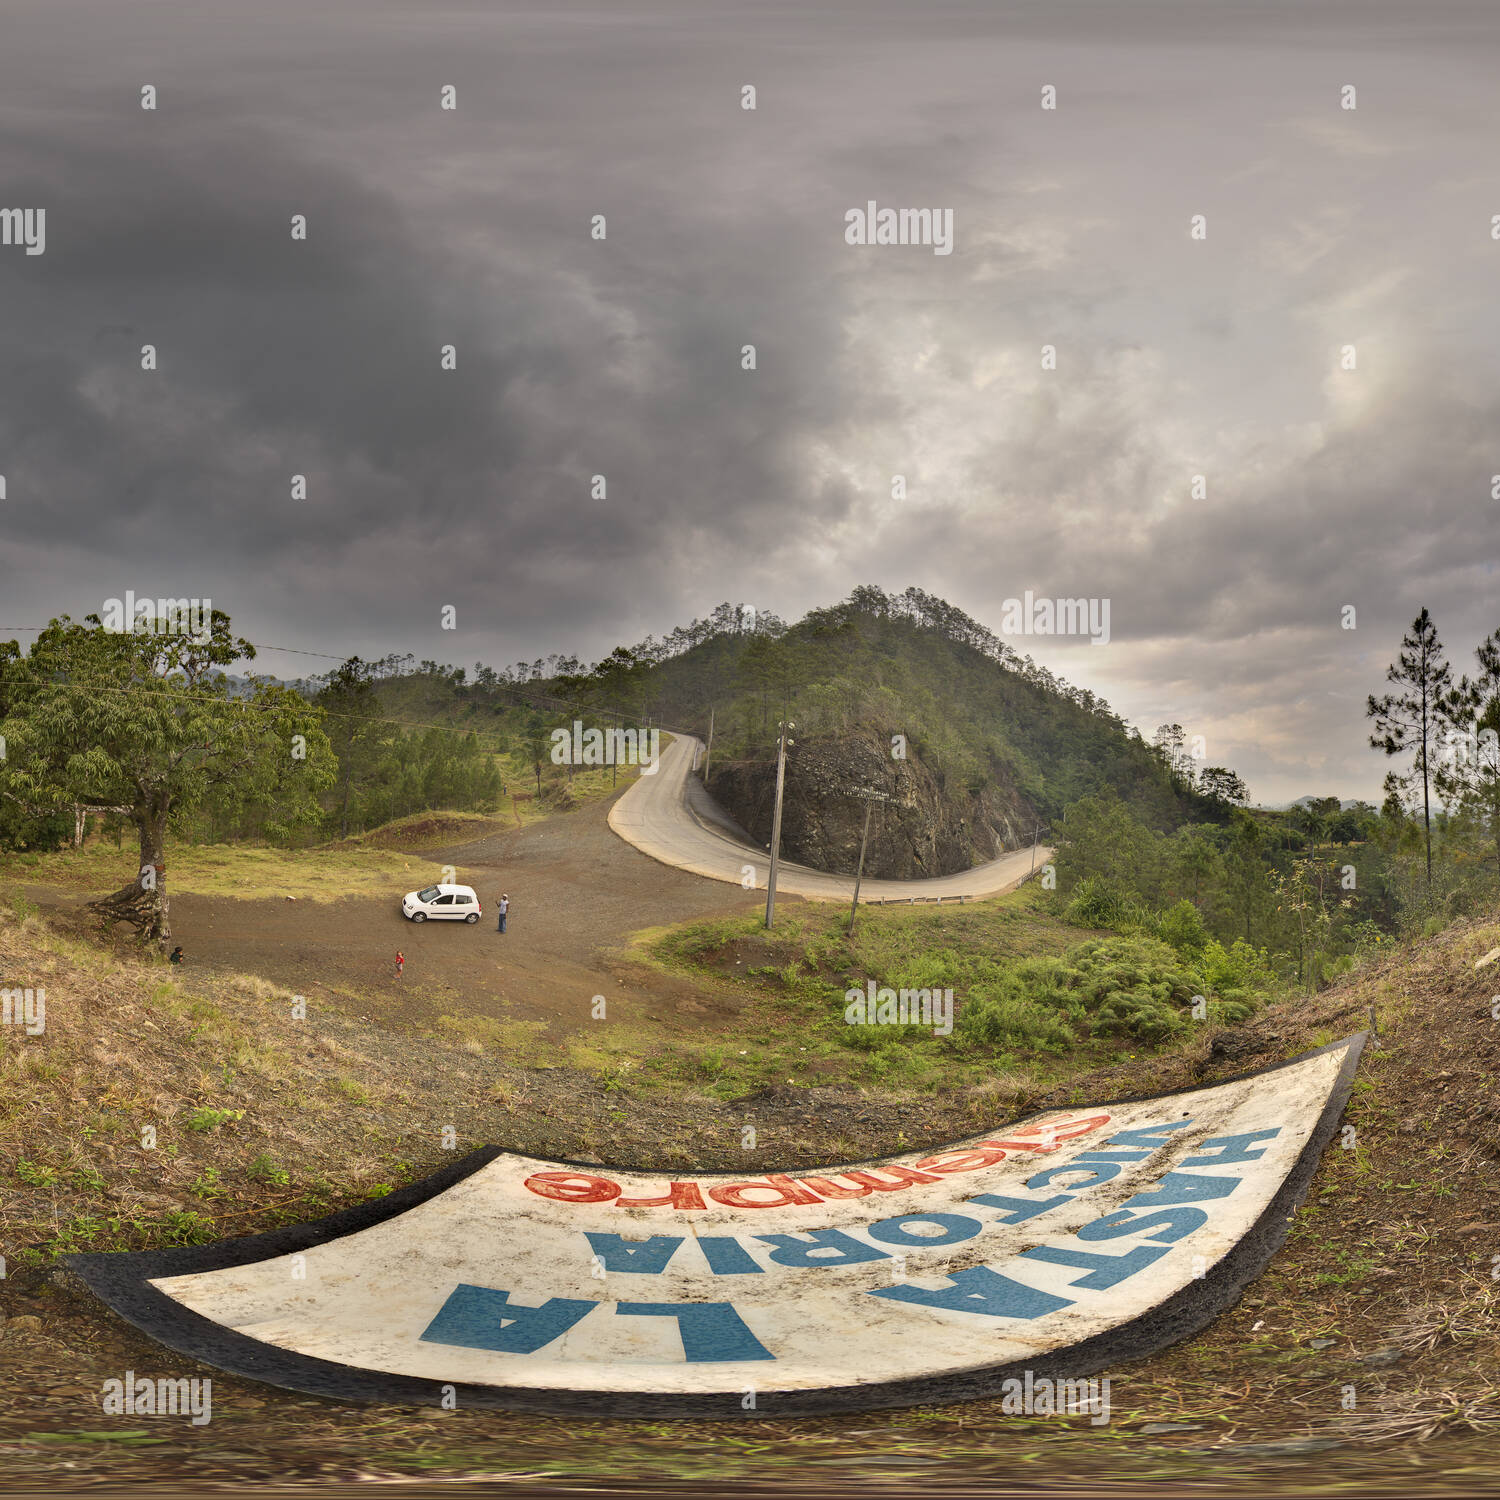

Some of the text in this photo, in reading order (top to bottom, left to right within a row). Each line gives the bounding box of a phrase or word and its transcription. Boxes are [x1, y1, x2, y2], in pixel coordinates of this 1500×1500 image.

[419, 1127, 1282, 1362] HASTA LA
[583, 1119, 1194, 1274] VICTORIA
